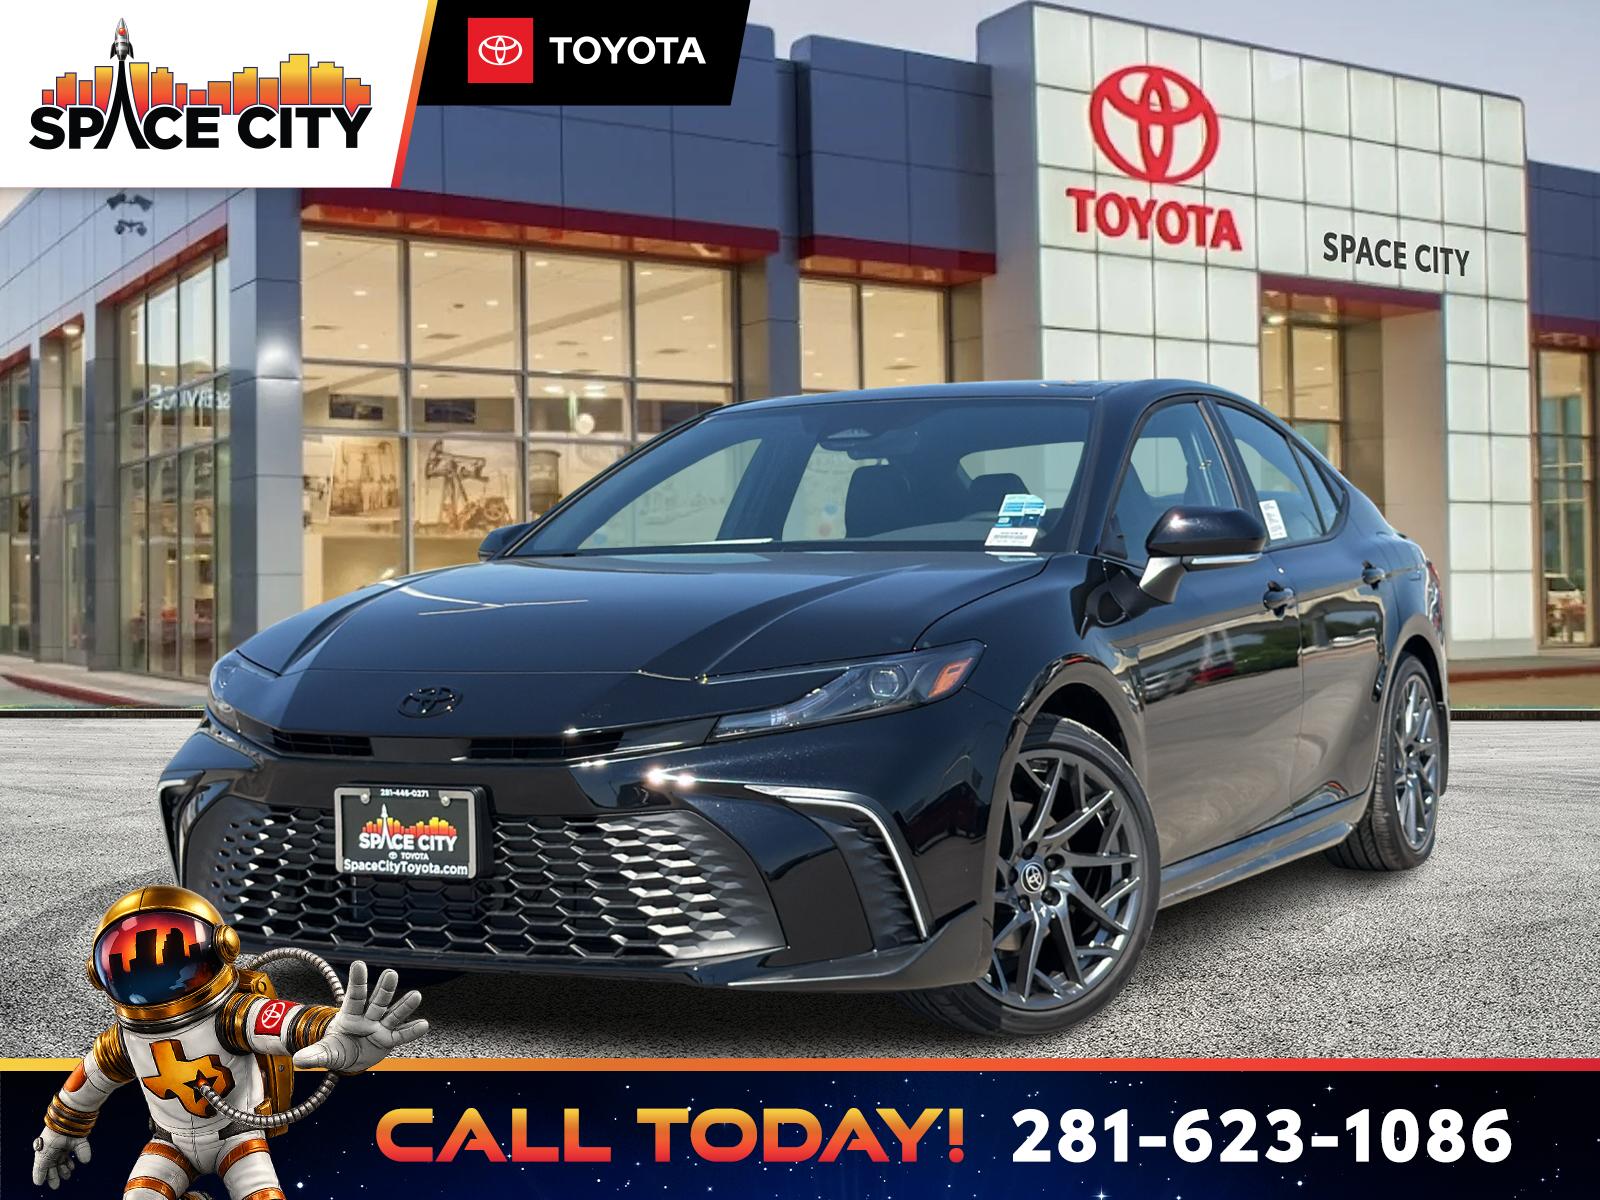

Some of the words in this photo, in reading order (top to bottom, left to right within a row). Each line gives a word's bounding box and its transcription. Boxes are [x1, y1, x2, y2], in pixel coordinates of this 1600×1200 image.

[1066, 187, 1242, 251] TOYOTA
[1323, 232, 1407, 270] SPACE
[1414, 244, 1470, 277] CITY
[358, 832, 415, 850] SPACE
[417, 835, 458, 851] CITY
[400, 852, 430, 861] TOYOTA
[343, 858, 468, 876] SpaceCityToyota.com
